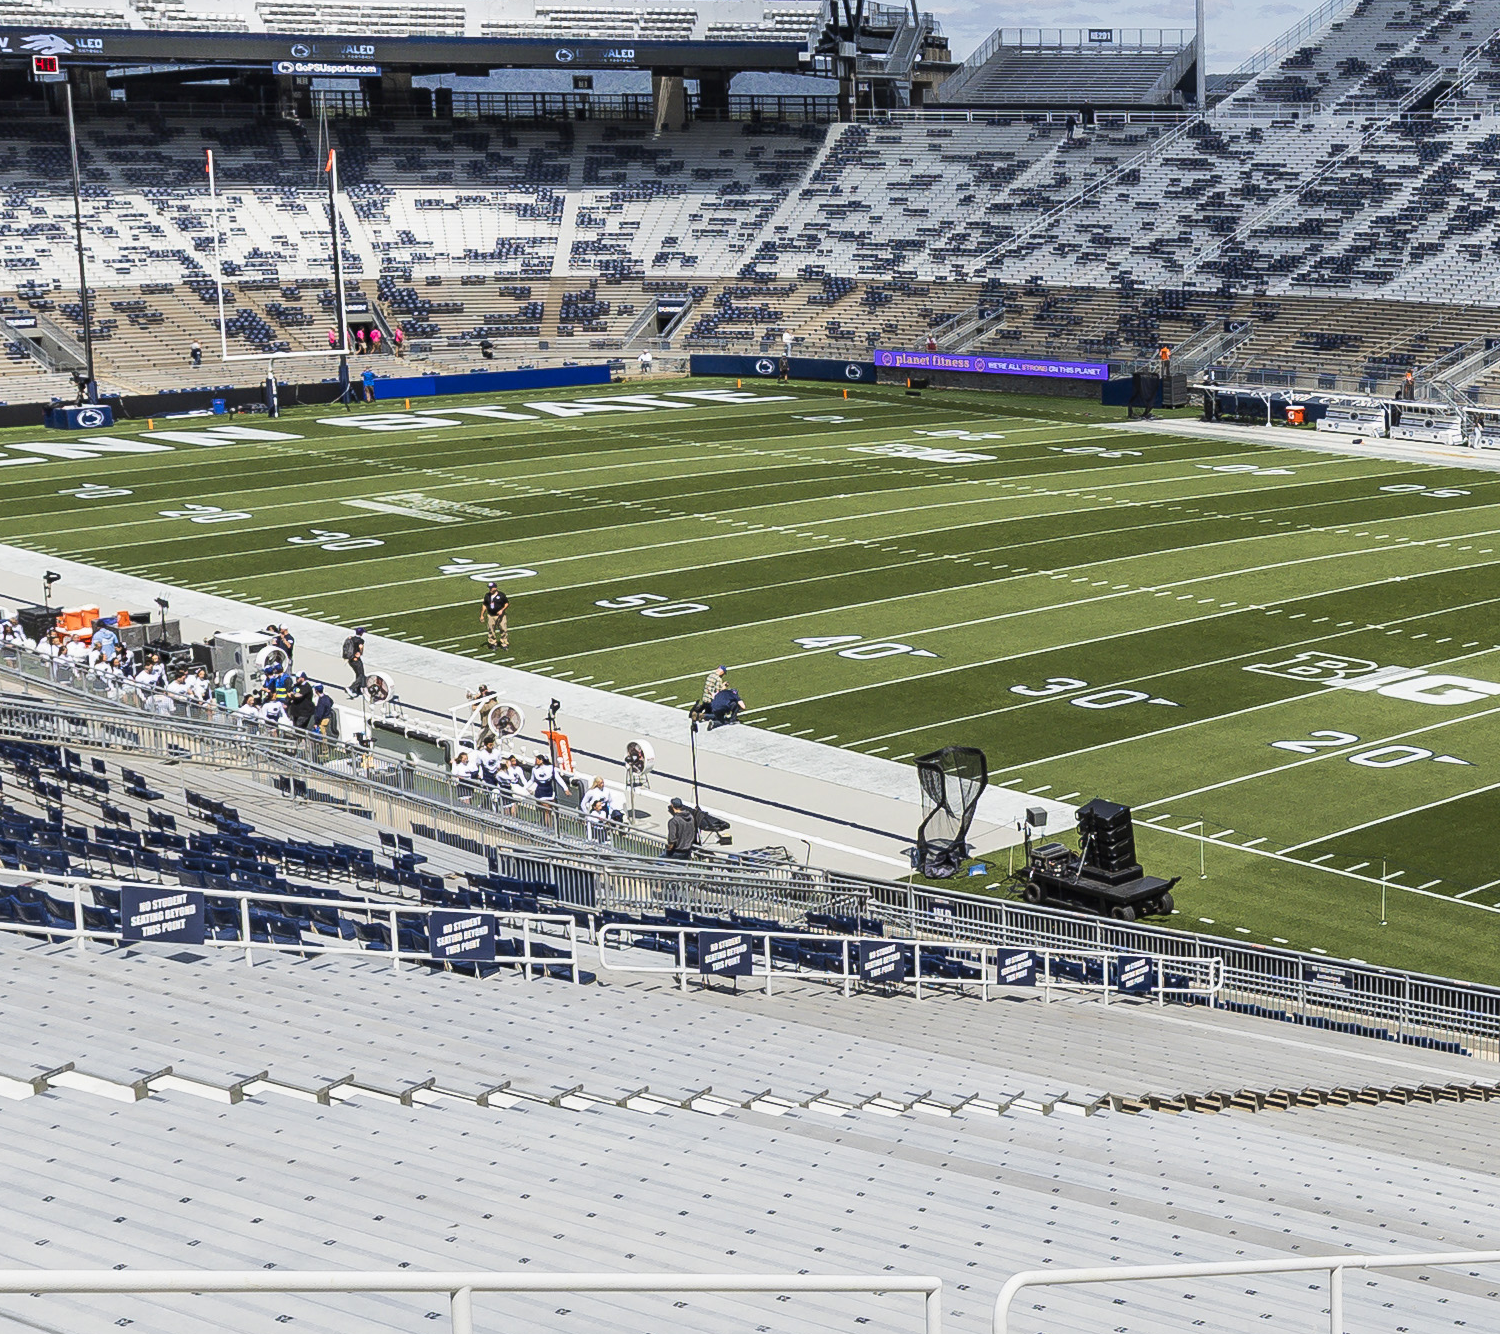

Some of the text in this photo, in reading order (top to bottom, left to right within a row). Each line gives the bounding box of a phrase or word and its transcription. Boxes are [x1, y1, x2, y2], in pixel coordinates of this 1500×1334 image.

[295, 63, 377, 75] GoPSUsports.com
[896, 354, 970, 368] planet fitness
[315, 389, 799, 430] STATE
[159, 507, 253, 524] 20
[287, 531, 385, 551] 30
[438, 562, 538, 582] 40
[595, 593, 710, 618] 50
[794, 635, 914, 660] 40
[1010, 677, 1151, 708] 30
[1269, 729, 1434, 768] 20
